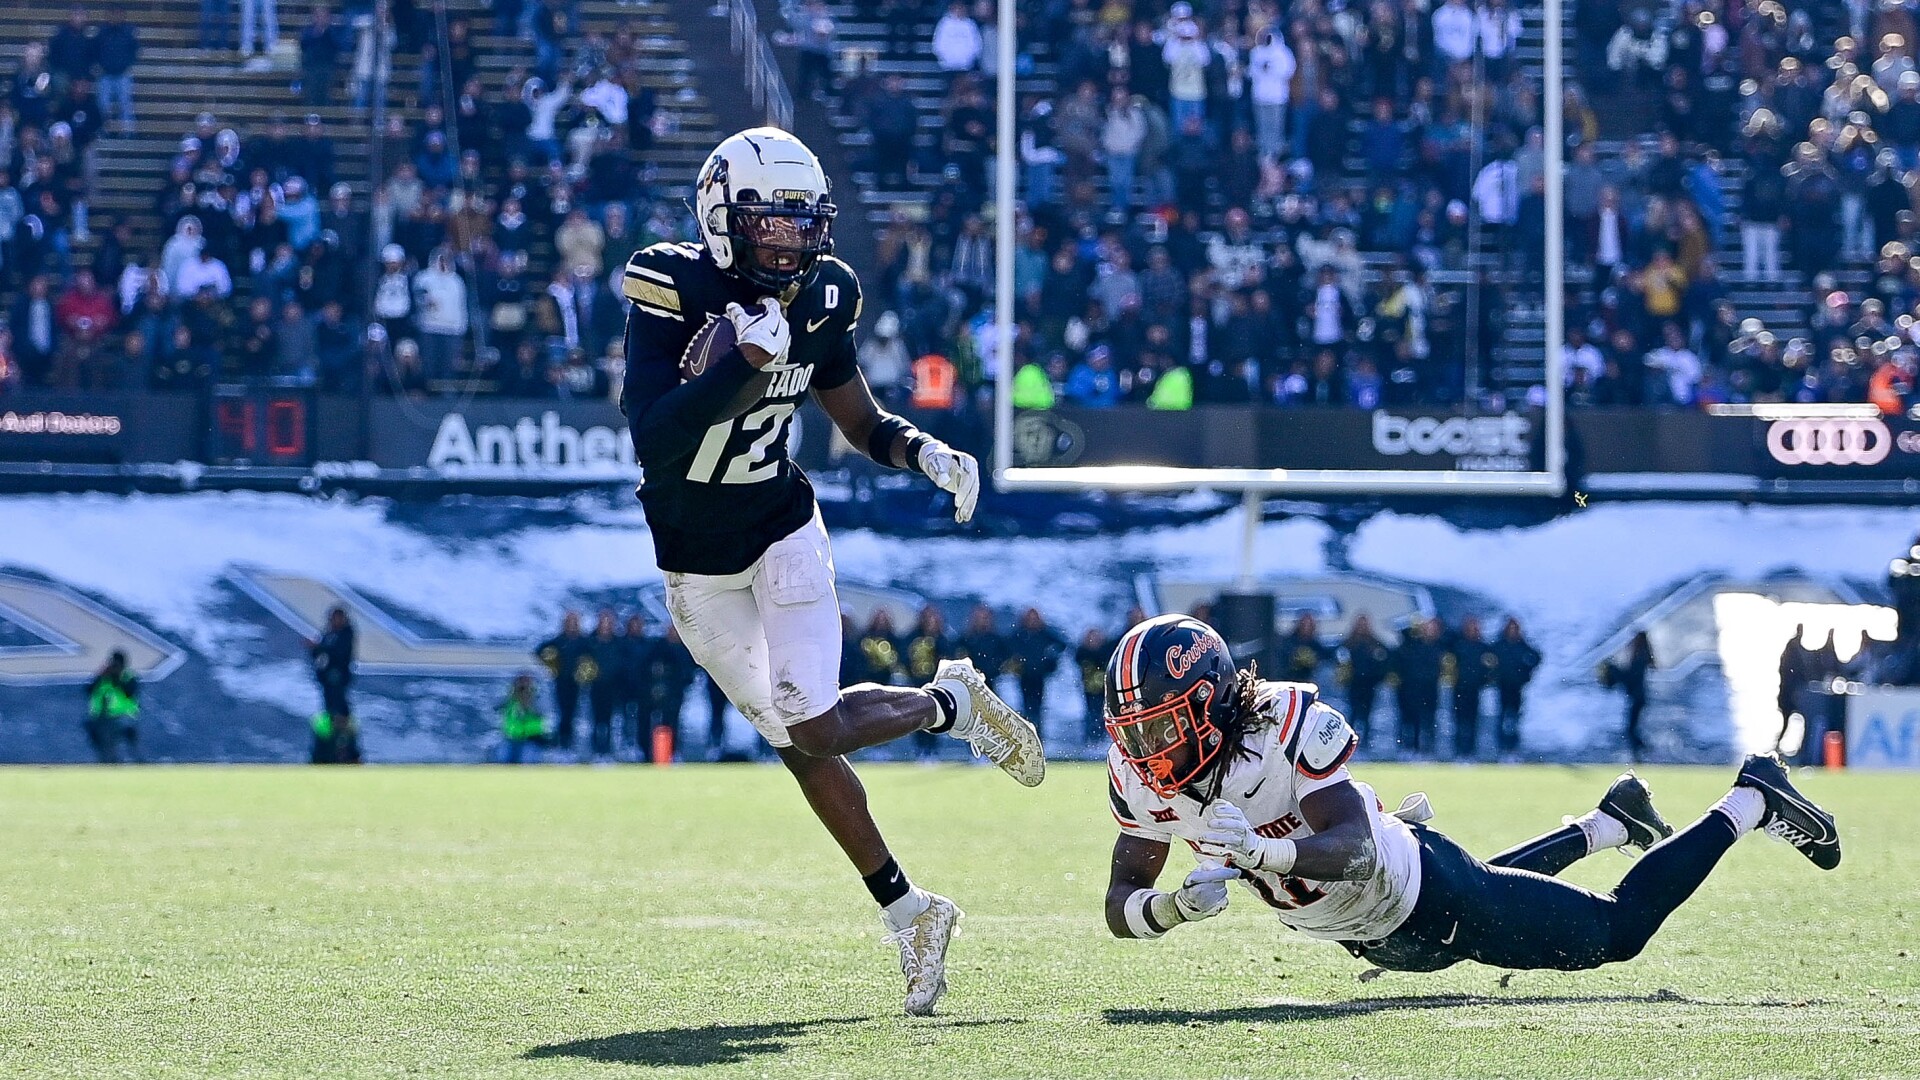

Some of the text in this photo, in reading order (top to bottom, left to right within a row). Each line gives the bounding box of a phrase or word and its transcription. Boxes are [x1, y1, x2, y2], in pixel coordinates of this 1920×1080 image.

[784, 190, 805, 200] BUFFS
[825, 285, 839, 308] D
[761, 363, 814, 398] RADO
[217, 401, 304, 454] 40
[427, 410, 637, 466] Anthe
[686, 403, 796, 484] 12
